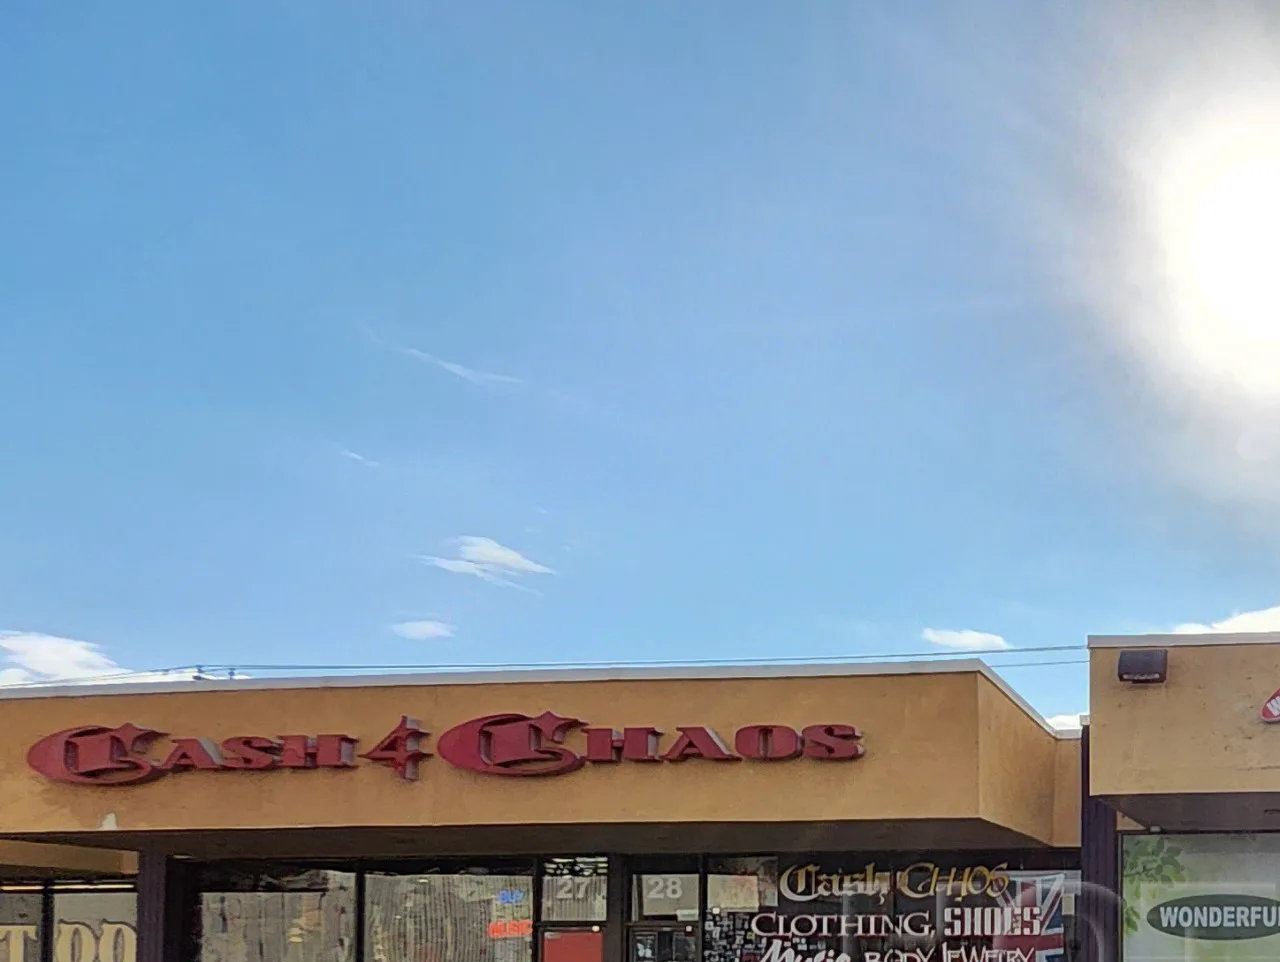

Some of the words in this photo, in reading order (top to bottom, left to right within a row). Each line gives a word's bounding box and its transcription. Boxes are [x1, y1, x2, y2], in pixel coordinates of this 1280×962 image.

[358, 715, 434, 781] 4
[555, 878, 592, 899] 27
[647, 877, 684, 899] 28
[751, 910, 936, 938] CLOTHING,
[944, 907, 1041, 936] SHOES
